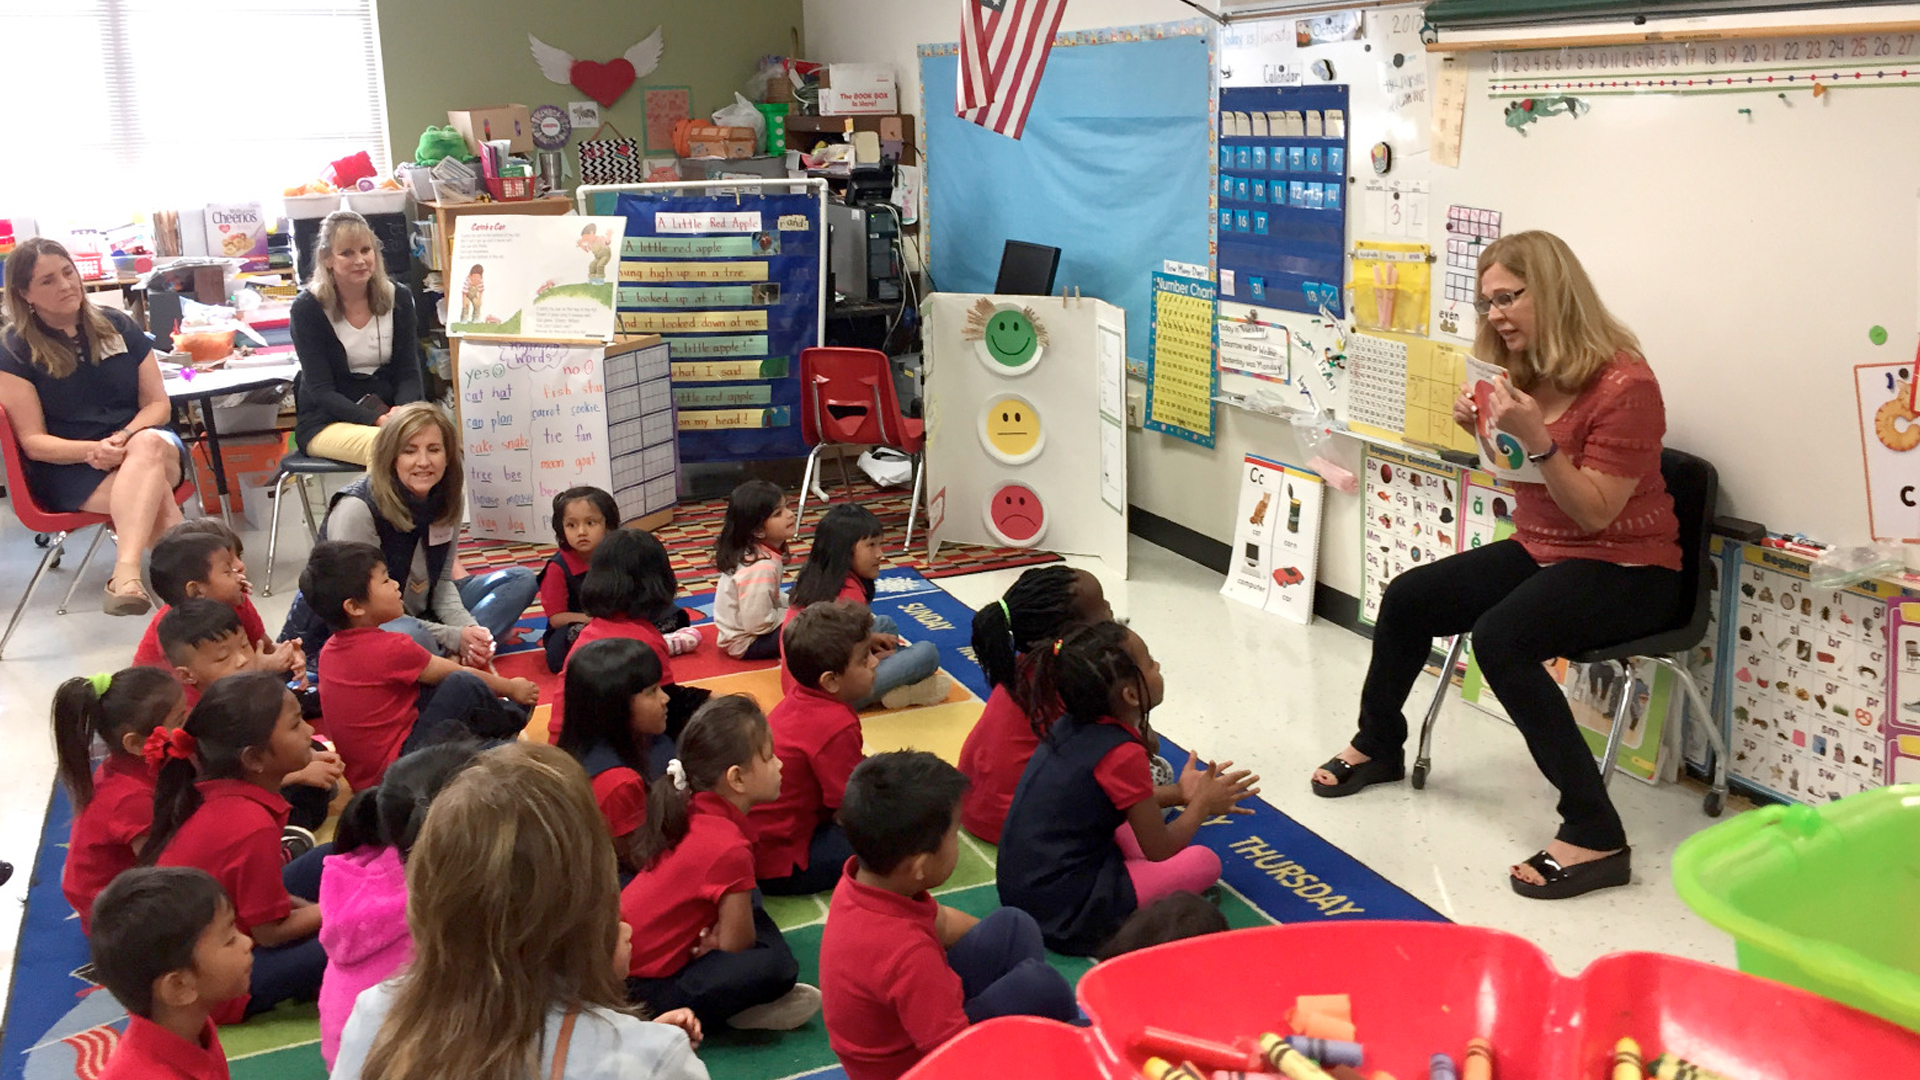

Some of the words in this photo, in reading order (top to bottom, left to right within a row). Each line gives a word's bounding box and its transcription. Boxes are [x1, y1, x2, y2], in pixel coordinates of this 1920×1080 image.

[1704, 47, 1717, 65] 18
[1723, 45, 1738, 63] 19
[1743, 45, 1757, 62] 20
[1763, 43, 1777, 61] 21
[1784, 42, 1800, 60] 22
[1806, 41, 1822, 59] 23
[1828, 39, 1845, 58] 24
[1851, 37, 1868, 57] 25
[1874, 36, 1892, 56] 26
[1897, 34, 1915, 55] 27
[1241, 151, 1247, 164] 2
[1256, 151, 1262, 164] 3
[1293, 152, 1300, 165] 5
[1311, 153, 1318, 166] 6
[1332, 152, 1339, 166] 7
[1224, 180, 1230, 192] 8
[1239, 182, 1246, 195] 9
[1255, 184, 1264, 197] 10
[1274, 185, 1282, 198] 11
[1292, 187, 1302, 200] 12
[1221, 213, 1231, 226] 15
[1238, 215, 1247, 228] 16
[1257, 217, 1266, 229] 17
[1391, 203, 1401, 225] 3
[658, 217, 666, 229] A
[672, 216, 702, 229] Little
[709, 216, 726, 229] Red
[731, 216, 759, 233] Apple
[625, 241, 634, 252] A
[640, 240, 667, 253] little
[672, 242, 692, 254] red
[695, 243, 722, 256] apple
[650, 267, 673, 281] high
[677, 270, 690, 280] up
[712, 270, 719, 278] a
[617, 290, 627, 303] I
[636, 291, 669, 303] looked
[1156, 276, 1189, 294] Number
[1190, 282, 1214, 300] Chart
[661, 315, 696, 328] looked
[701, 315, 726, 328] down
[730, 315, 741, 327] at
[1439, 309, 1460, 321] even
[465, 369, 490, 388] yes
[562, 365, 580, 376] no
[705, 365, 713, 376] I
[465, 390, 484, 402] cat
[492, 384, 512, 399] hat
[544, 384, 572, 398] fish
[531, 404, 561, 420] carrot
[571, 402, 601, 416] cookie
[466, 417, 485, 429] can
[491, 411, 513, 432] plan
[470, 440, 494, 454] cake
[501, 433, 529, 449] snake
[544, 428, 563, 444] tie
[575, 424, 592, 442] fan
[471, 467, 493, 480] tree
[503, 465, 522, 480] bee
[575, 451, 596, 475] goat
[1366, 459, 1377, 471] Bb
[1396, 468, 1406, 479] Cc
[1426, 476, 1438, 487] Dd
[1249, 467, 1264, 485] Cc
[1366, 483, 1374, 494] Ff
[1396, 492, 1408, 506] Gg
[1426, 501, 1438, 514] Hh
[507, 515, 525, 531] dog
[1366, 506, 1375, 520] Jj
[1396, 516, 1406, 527] Kk
[1252, 529, 1262, 537] cat
[1284, 540, 1298, 549] corn
[1366, 530, 1381, 542] Mm
[1395, 539, 1407, 551] Nn
[1425, 549, 1436, 561] Pp
[1237, 578, 1266, 593] computer
[1753, 569, 1764, 581] bl
[1791, 581, 1802, 593] cl
[1833, 591, 1842, 605] fl
[1366, 598, 1376, 610] Xx
[897, 602, 956, 631] SUNDAY
[1751, 612, 1762, 624] pl
[1790, 624, 1800, 636] sl
[1828, 635, 1842, 648] br
[1870, 651, 1883, 662] cr
[1748, 654, 1761, 666] dr
[1787, 666, 1798, 678] fr
[1825, 682, 1839, 695] gr
[1866, 696, 1880, 708] pr
[1784, 710, 1797, 723] sk
[1821, 725, 1840, 738] sm
[1863, 741, 1877, 754] sn
[1743, 738, 1757, 752] sp
[1781, 753, 1794, 764] st
[1818, 768, 1836, 781] sw
[1228, 835, 1365, 916] THURSDAY
